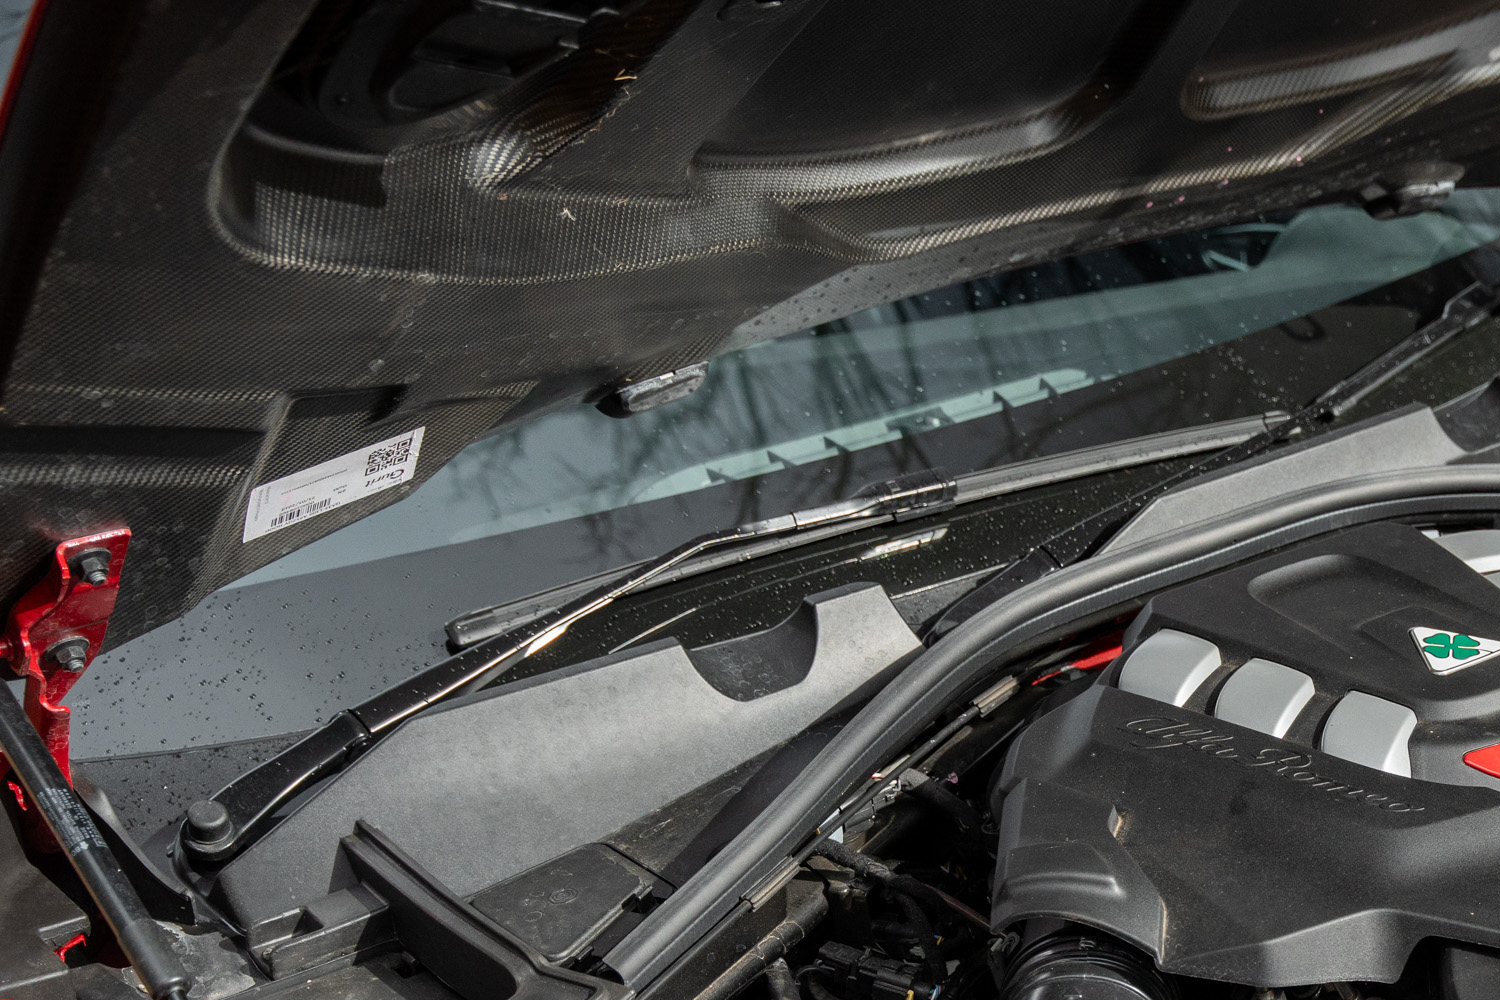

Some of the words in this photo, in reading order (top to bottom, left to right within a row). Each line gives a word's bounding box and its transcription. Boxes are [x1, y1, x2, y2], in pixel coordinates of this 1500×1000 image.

[365, 469, 404, 487] Gurit
[1116, 716, 1239, 759] Alfa
[1245, 748, 1426, 812] Romeo
